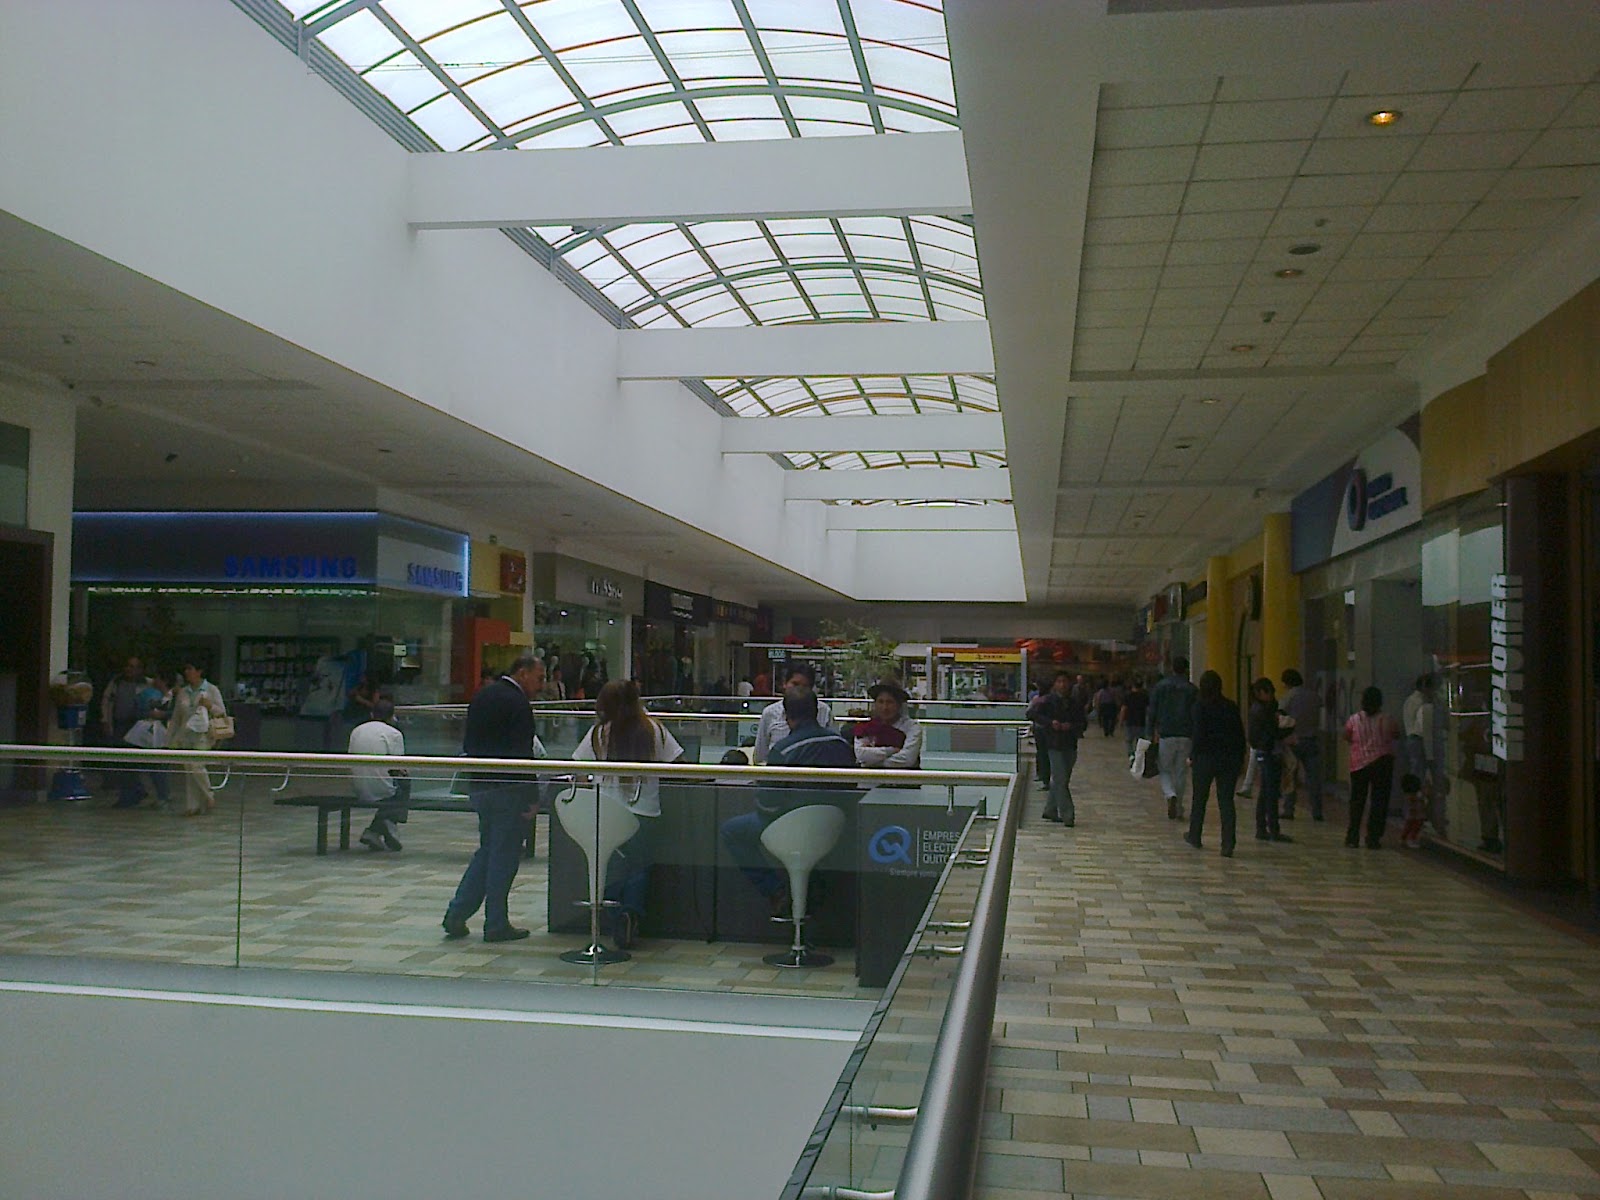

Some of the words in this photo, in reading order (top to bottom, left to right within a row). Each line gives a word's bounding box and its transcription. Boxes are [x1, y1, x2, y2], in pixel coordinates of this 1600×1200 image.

[224, 554, 357, 578] SAMSUNG
[407, 562, 463, 592] SAMSUNG
[1491, 572, 1512, 761] EXPLORER
